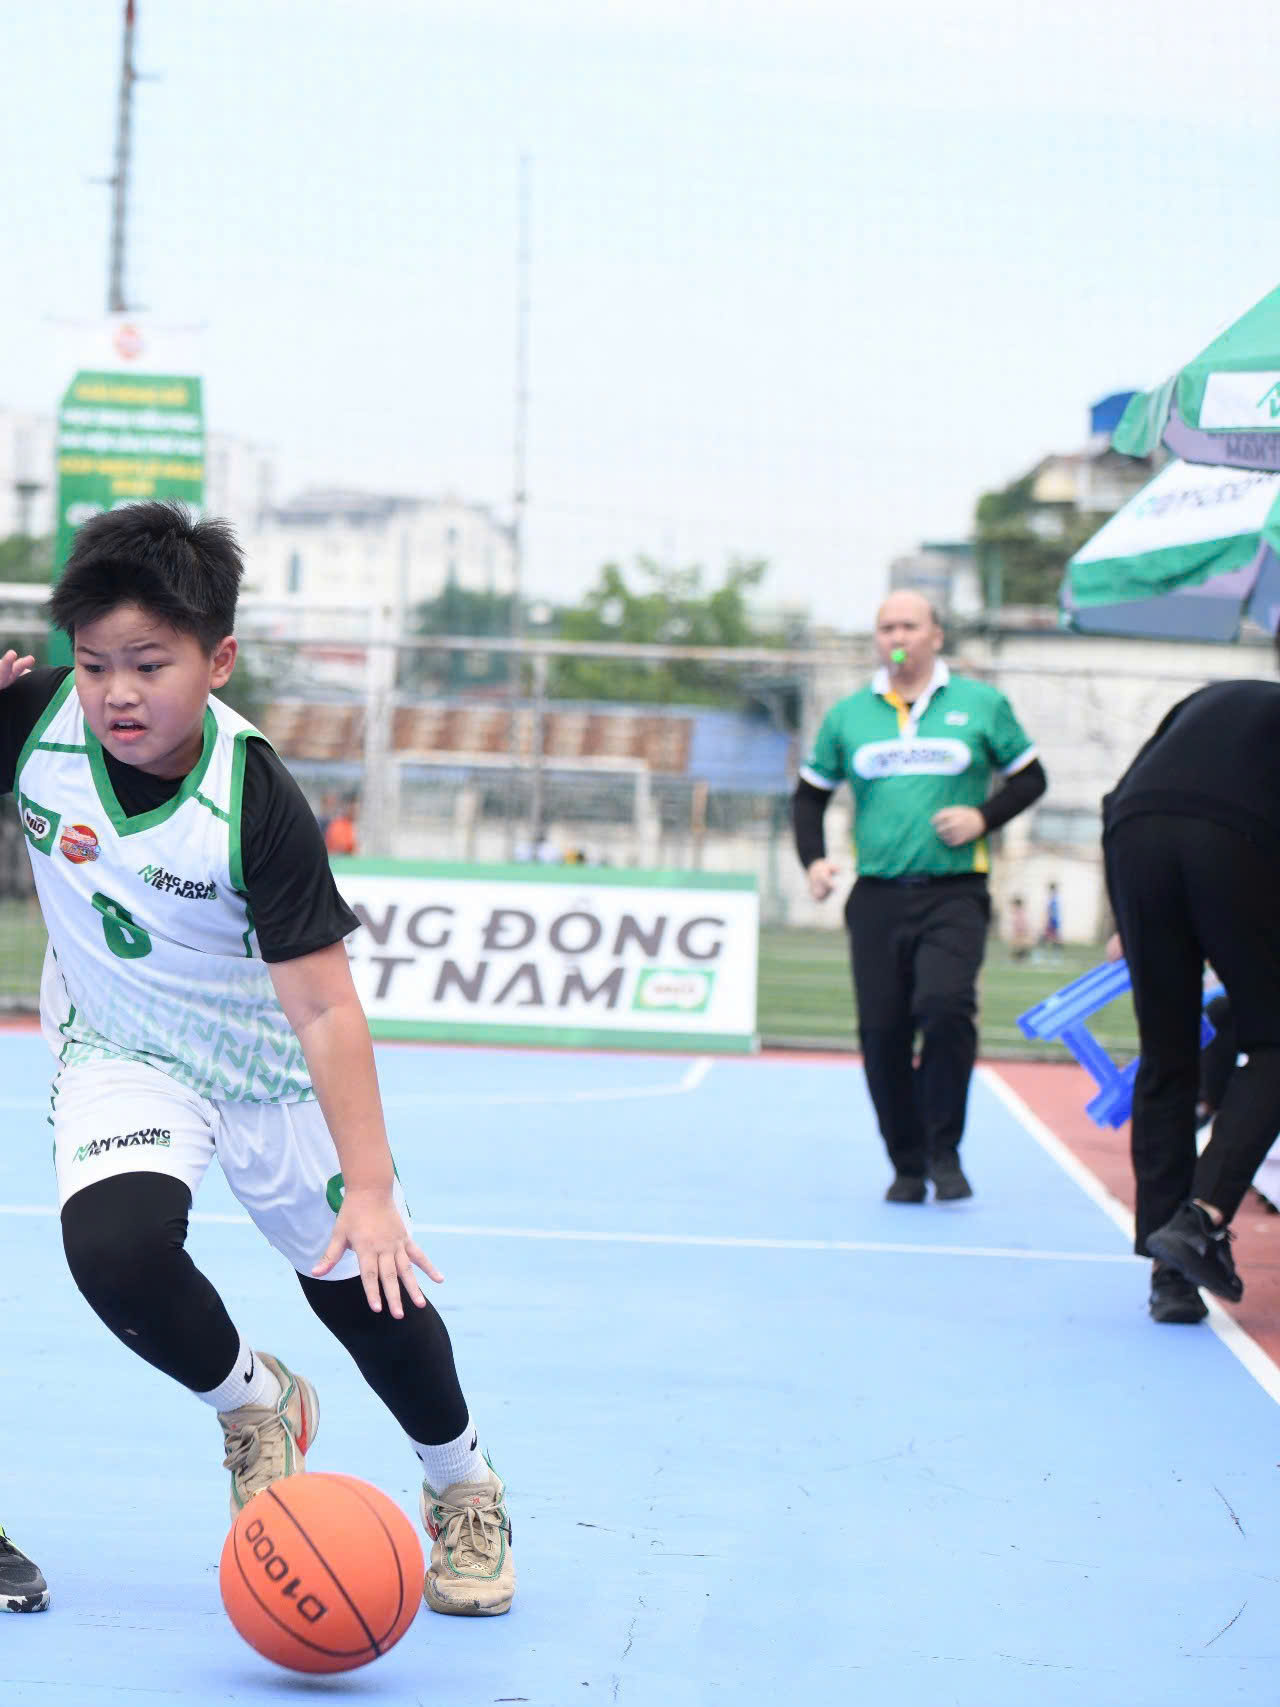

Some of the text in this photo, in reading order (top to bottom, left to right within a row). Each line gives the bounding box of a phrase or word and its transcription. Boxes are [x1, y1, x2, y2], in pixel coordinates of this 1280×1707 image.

[174, 887, 208, 900] NAM
[350, 903, 456, 949] NG
[432, 958, 625, 1009] NAM
[117, 1137, 155, 1149] NAM
[244, 1519, 328, 1623] D1000
